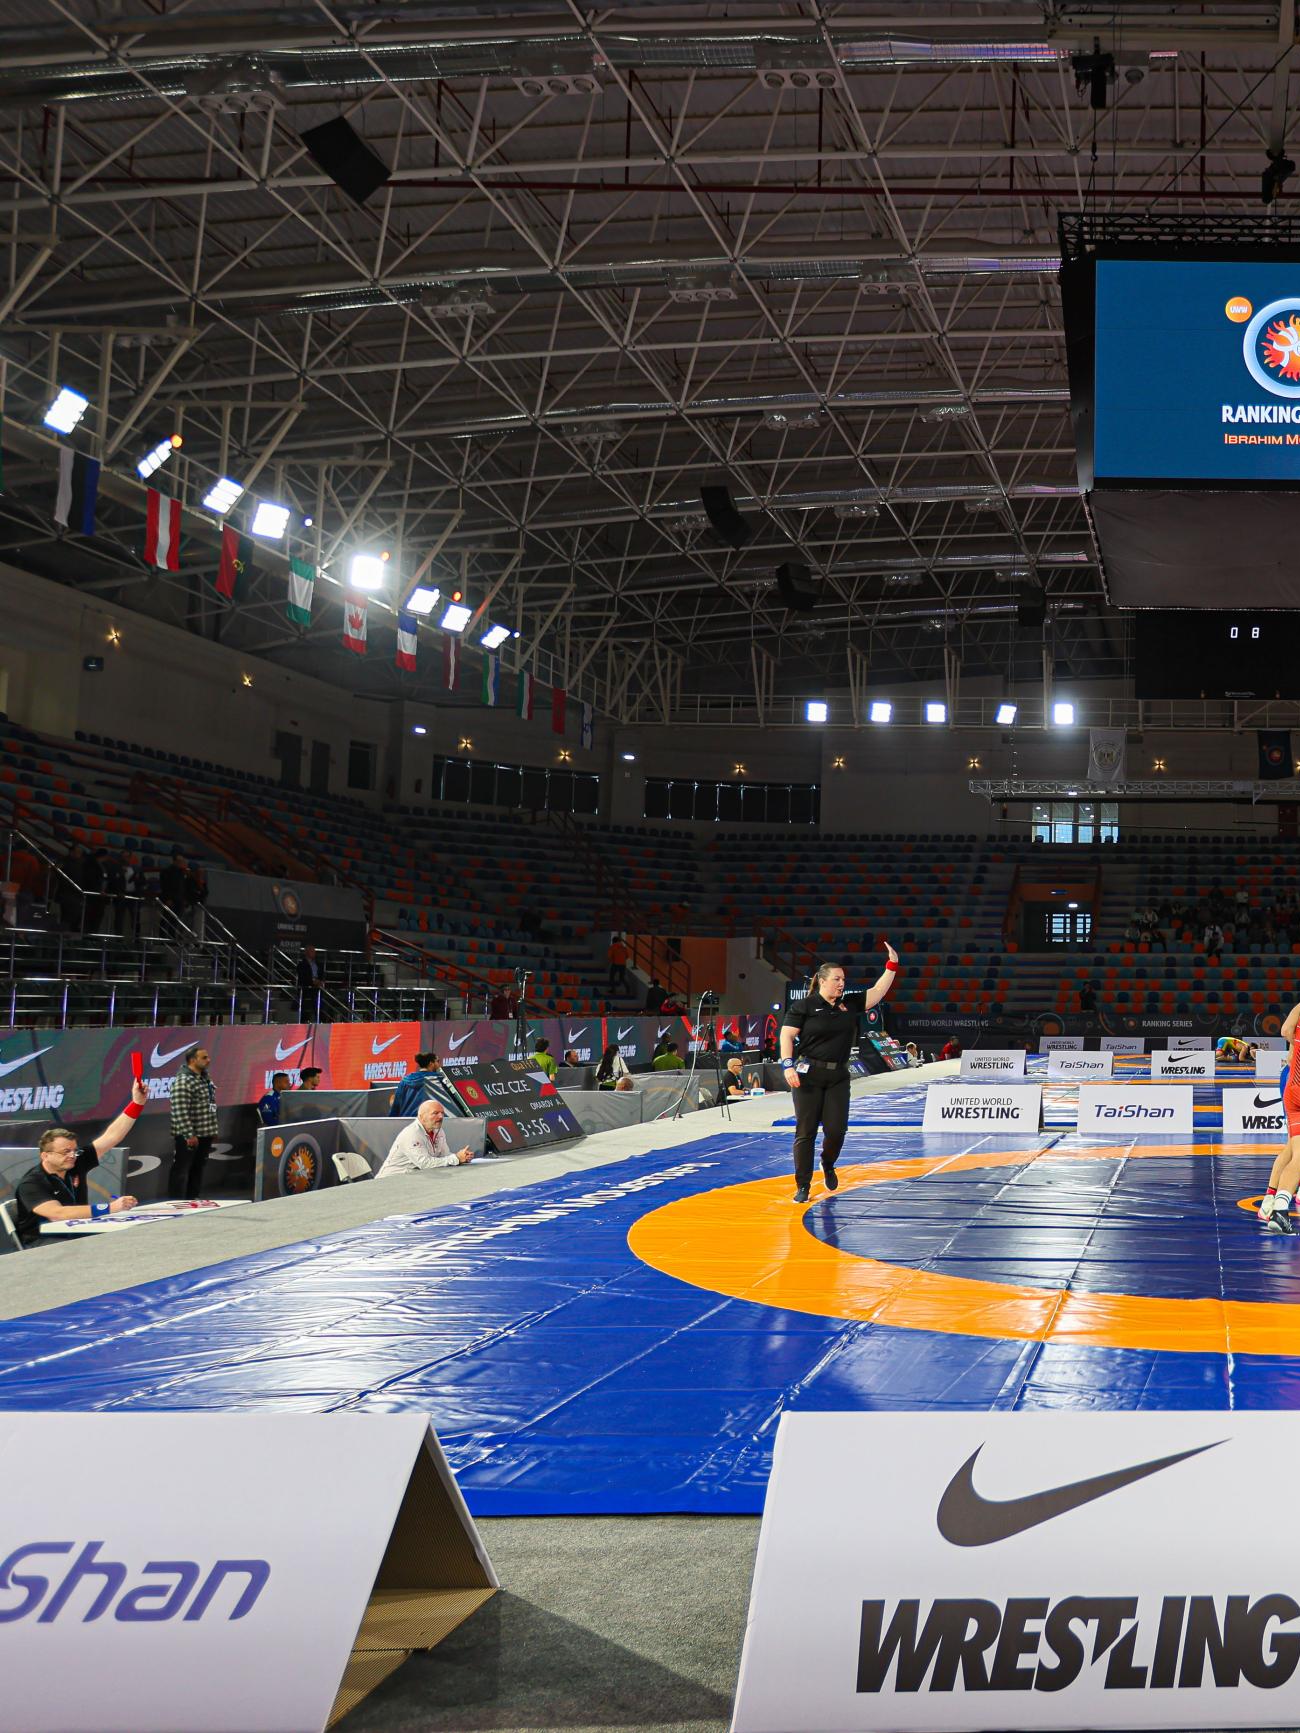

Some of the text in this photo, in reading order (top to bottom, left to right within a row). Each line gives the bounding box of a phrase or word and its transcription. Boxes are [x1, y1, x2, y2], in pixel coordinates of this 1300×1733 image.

[1224, 433, 1283, 445] IBRAHIM
[1230, 627, 1260, 639] 0 8
[790, 989, 810, 1000] UNIT
[931, 1019, 953, 1027] WORLD
[1142, 1020, 1193, 1028] RANKING SERIES
[364, 1061, 407, 1081] WRESTLING
[463, 1066, 474, 1075] 97
[970, 1061, 1014, 1069] WRESTLING
[1060, 1061, 1104, 1069] TaiShan
[1160, 1066, 1206, 1075] WRESTLING
[484, 1080, 531, 1097] KGZ CZE
[950, 1097, 1013, 1105] UNITED WORLD
[941, 1107, 1020, 1119] WRESTLING
[1095, 1104, 1175, 1118] TaiShan
[517, 1118, 551, 1138] 3:56
[558, 1115, 570, 1131] 1
[497, 1125, 512, 1144] 0
